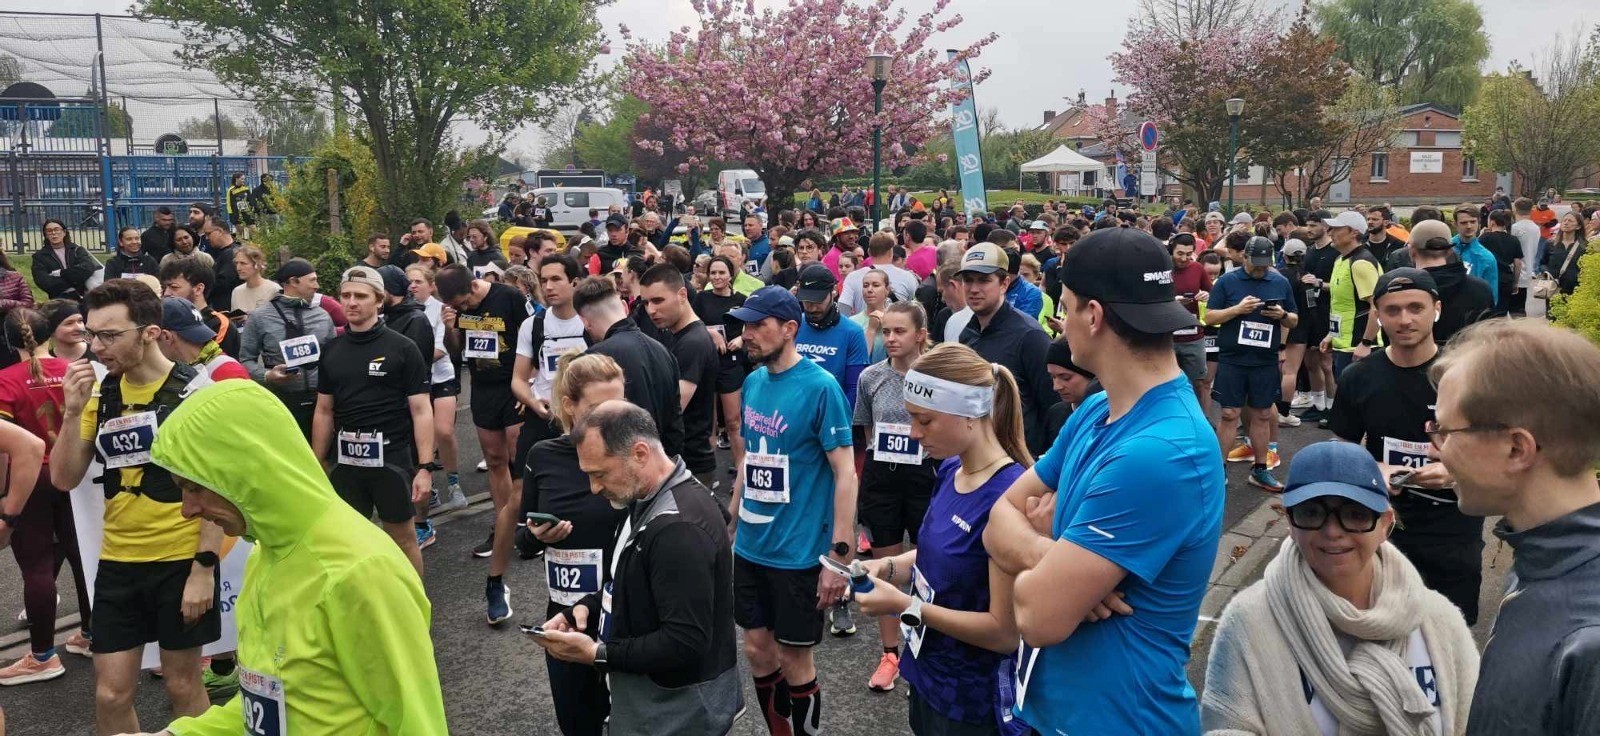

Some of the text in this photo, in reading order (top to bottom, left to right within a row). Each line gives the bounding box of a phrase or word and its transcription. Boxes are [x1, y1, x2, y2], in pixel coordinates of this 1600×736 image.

[1249, 329, 1263, 340] 471
[292, 344, 311, 357] 488
[474, 338, 489, 350] 227
[796, 343, 837, 355] BROOKS
[369, 362, 382, 370] EY
[112, 431, 143, 451] 432
[887, 435, 909, 452] 501
[347, 443, 371, 456] 002
[751, 469, 772, 488] 463
[554, 566, 580, 588] 182
